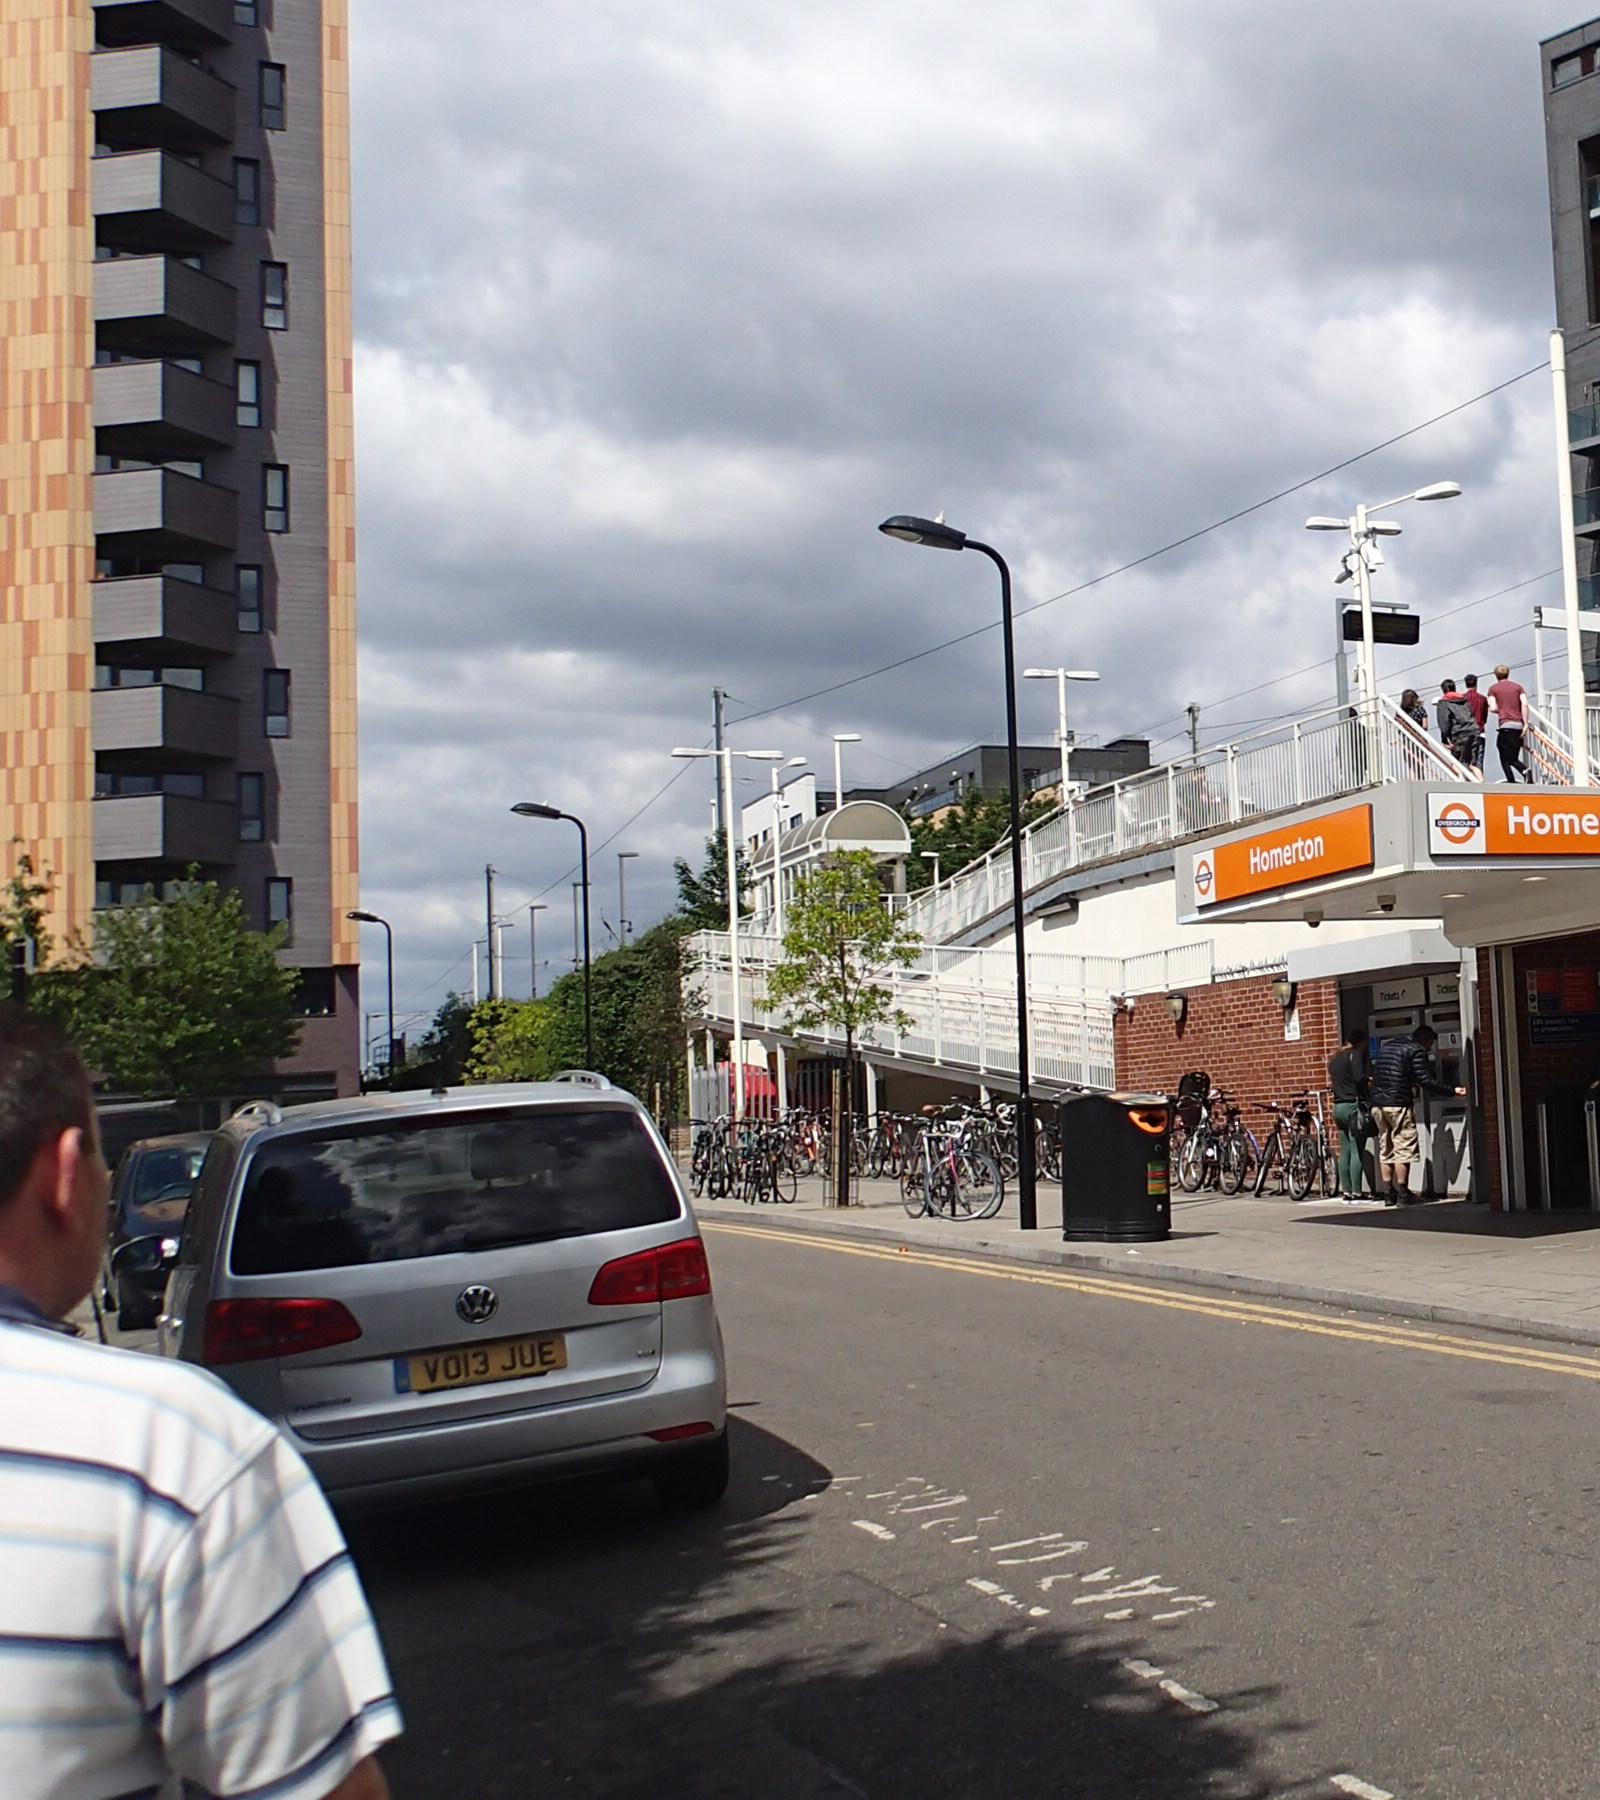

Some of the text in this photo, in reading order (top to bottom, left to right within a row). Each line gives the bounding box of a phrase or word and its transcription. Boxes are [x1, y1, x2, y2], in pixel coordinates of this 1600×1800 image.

[1437, 819, 1478, 827] OVERGROUND
[1249, 835, 1324, 875] Homerton
[500, 1340, 557, 1372] JUE
